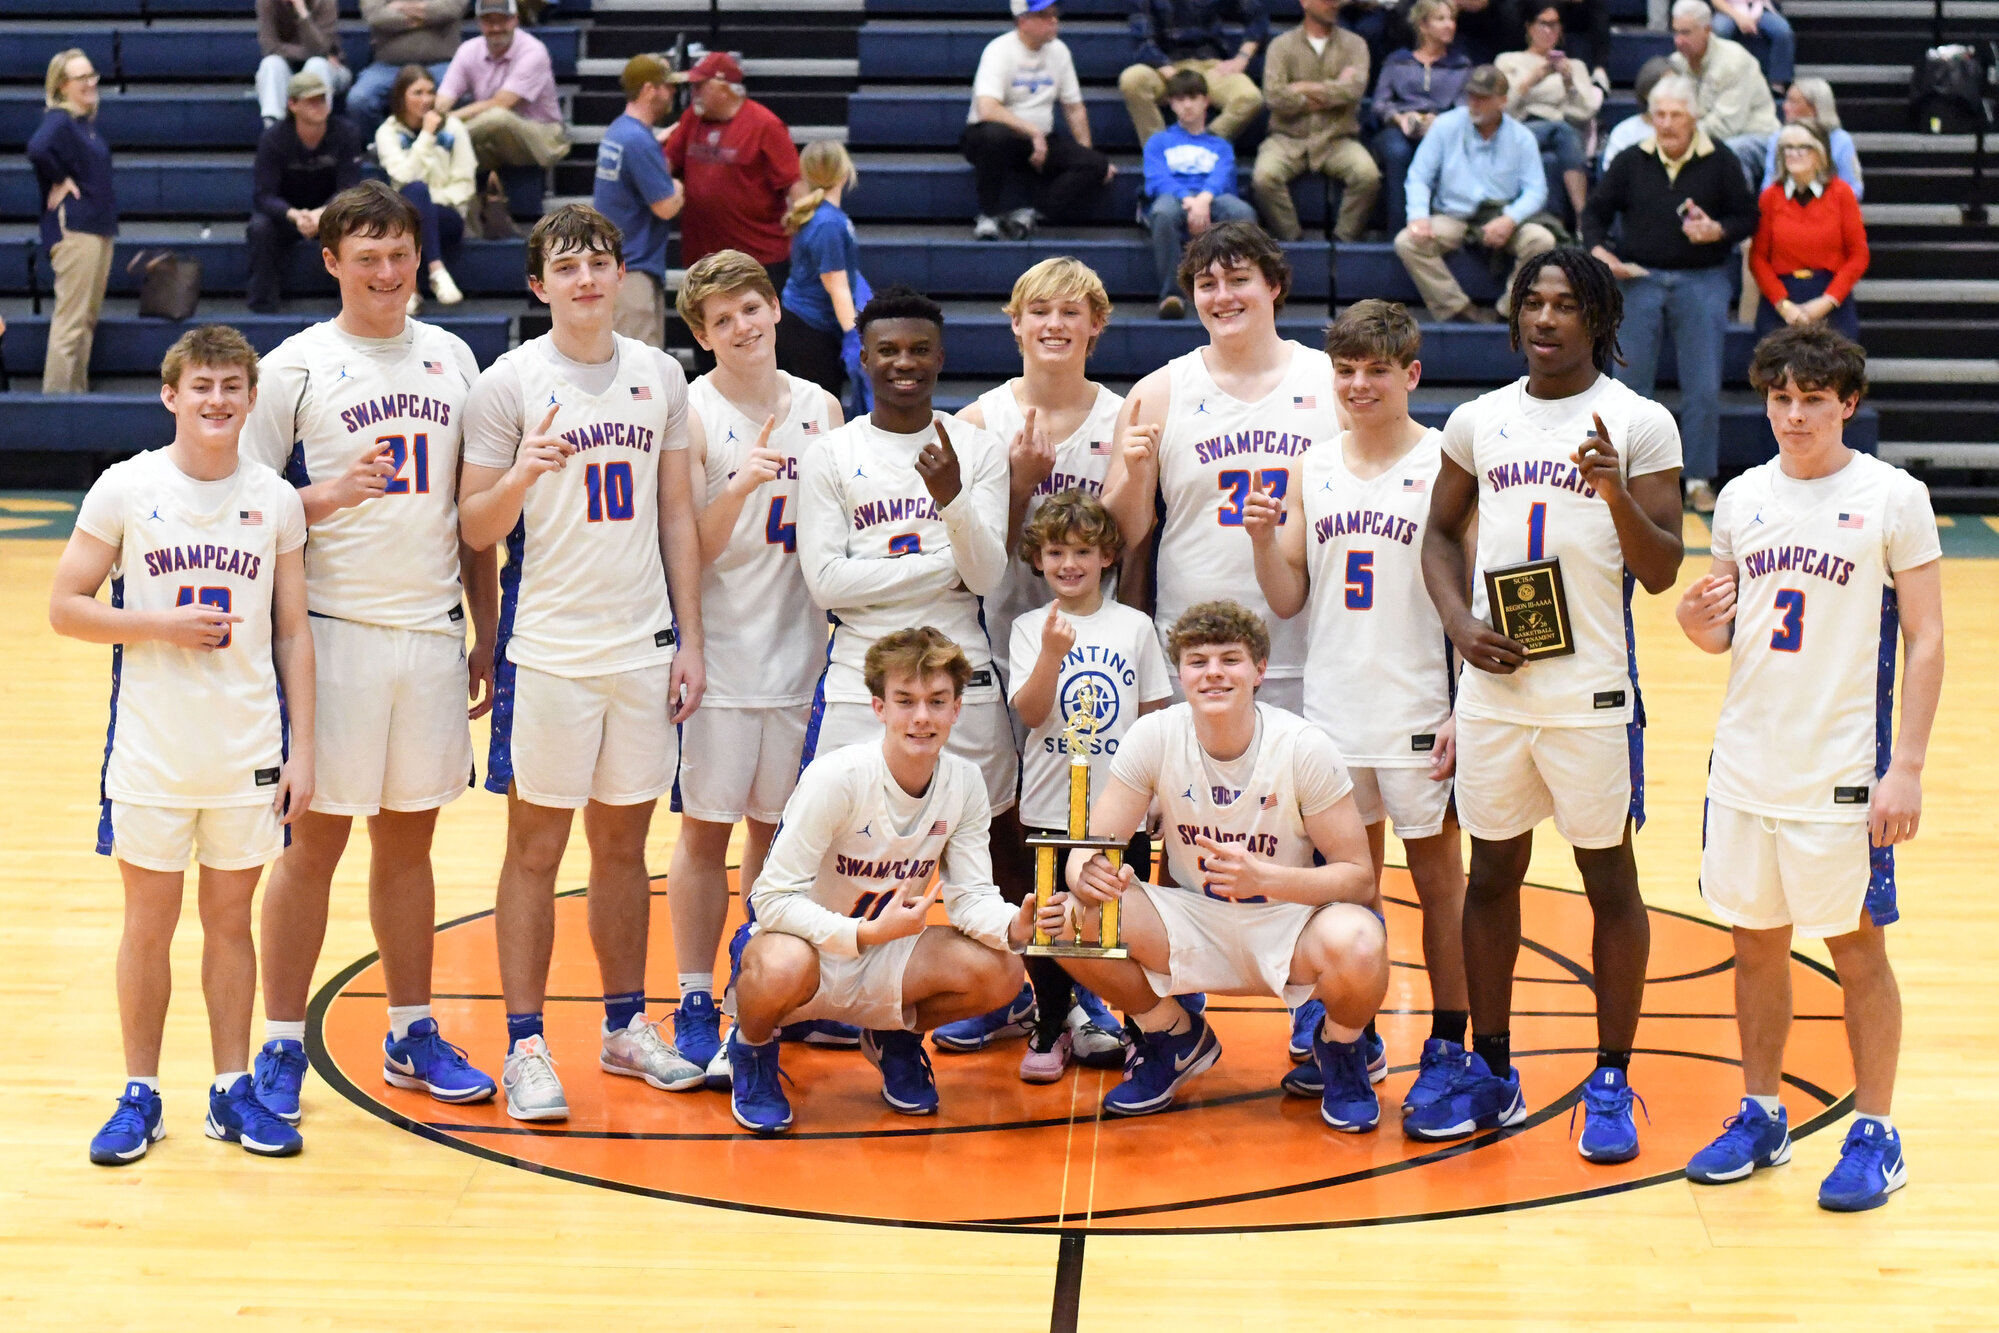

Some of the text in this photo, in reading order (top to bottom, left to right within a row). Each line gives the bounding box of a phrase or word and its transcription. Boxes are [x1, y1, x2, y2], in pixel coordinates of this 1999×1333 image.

[340, 393, 451, 434] SWAMPCATS
[560, 422, 654, 454] WAMPCATS
[1194, 430, 1312, 465] SWAMPCATS
[375, 432, 430, 495] 21
[584, 460, 635, 523] 10
[1217, 467, 1290, 527] 32
[765, 495, 797, 554] 4
[853, 497, 943, 531] SWAMPCA
[1314, 510, 1418, 546] SWAMPCATS
[1526, 502, 1547, 561] 1
[144, 544, 261, 581] SWAMPCATS
[1344, 549, 1375, 611] 5
[1744, 545, 1856, 586] SWAMPCATS
[1505, 602, 1528, 613] REGION
[1769, 588, 1806, 654] 3
[1514, 627, 1553, 639] BASKETBALL
[1518, 632, 1556, 644] OURNAMENT
[1529, 641, 1543, 649] MVP
[1060, 645, 1136, 687] NTING
[1044, 737, 1120, 756] SESO
[836, 853, 936, 880] SWAMPCATS
